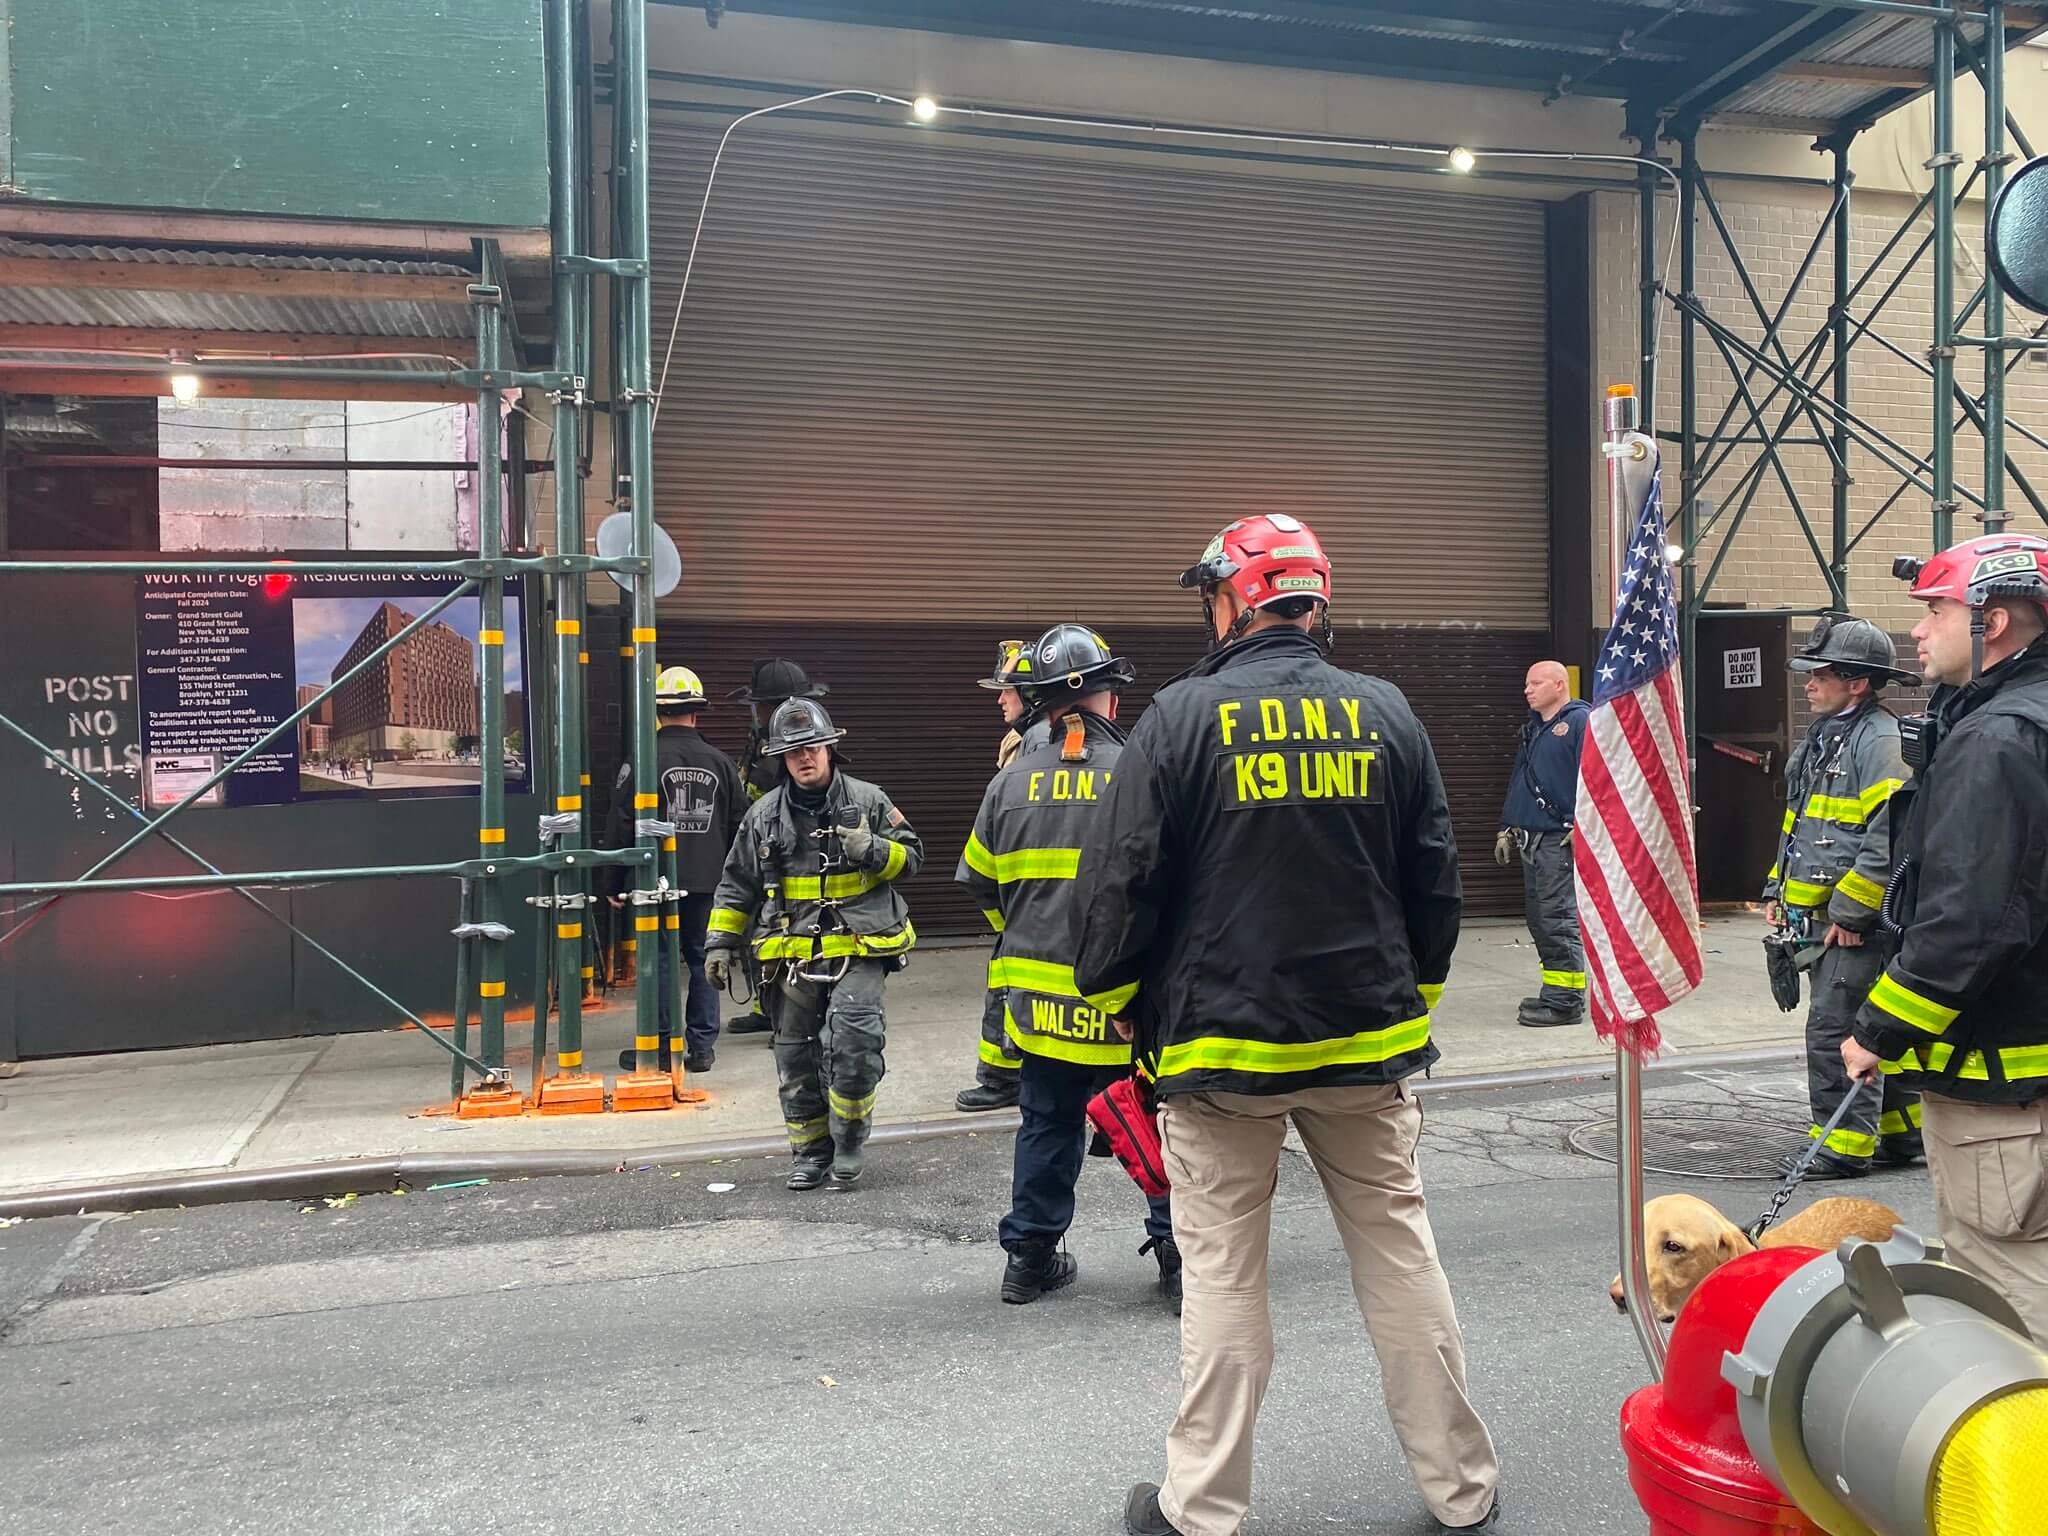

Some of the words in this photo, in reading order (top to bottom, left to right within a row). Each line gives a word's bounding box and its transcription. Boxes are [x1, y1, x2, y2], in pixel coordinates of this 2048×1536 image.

[1985, 553, 2031, 573] K-9
[144, 573, 191, 584] Work
[218, 573, 298, 587] Progres:
[303, 573, 396, 583] Residential
[401, 573, 415, 582] &
[420, 573, 518, 582] Commal
[1280, 576, 1321, 587] FDNY
[144, 592, 186, 600] Anticipated
[187, 591, 229, 599] Completion
[177, 612, 200, 620] Grand
[178, 620, 192, 628] 410
[216, 619, 238, 627] Street
[196, 628, 215, 636] York,
[160, 648, 200, 656] Additional
[200, 647, 248, 655] Information:
[1728, 653, 1739, 663] DO
[1741, 651, 1756, 662] NOT
[147, 666, 176, 674] General
[177, 665, 217, 673] Contractor:
[1730, 663, 1756, 674] BLOCK
[1730, 674, 1756, 684] EXIT
[45, 675, 133, 703] POST
[178, 690, 214, 698] Brooklyn,
[226, 689, 248, 697] 11231
[159, 710, 207, 719] anonymously
[208, 709, 232, 717] report
[232, 708, 256, 716] unsafe
[68, 709, 119, 737] NO
[149, 719, 189, 727] Conditions
[190, 718, 197, 726] at
[232, 717, 248, 725] site,
[263, 715, 278, 723] 311.
[1219, 698, 1379, 746] F.D.N.Y.
[150, 730, 166, 738] Para
[167, 729, 198, 738] reportar
[199, 728, 241, 736] condiciones
[242, 727, 274, 736] peligros
[172, 738, 189, 746] sitio
[189, 737, 199, 745] de
[200, 737, 228, 746] trabajo,
[229, 736, 249, 744] llame
[250, 735, 258, 743] al
[163, 746, 182, 754] tiene
[183, 747, 198, 755] que
[198, 745, 211, 753] dar
[155, 760, 180, 769] NYC
[668, 771, 713, 787] DIVISION
[1235, 752, 1288, 802] K9
[1300, 751, 1376, 799] UNIT
[1031, 999, 1107, 1041] WALSH
